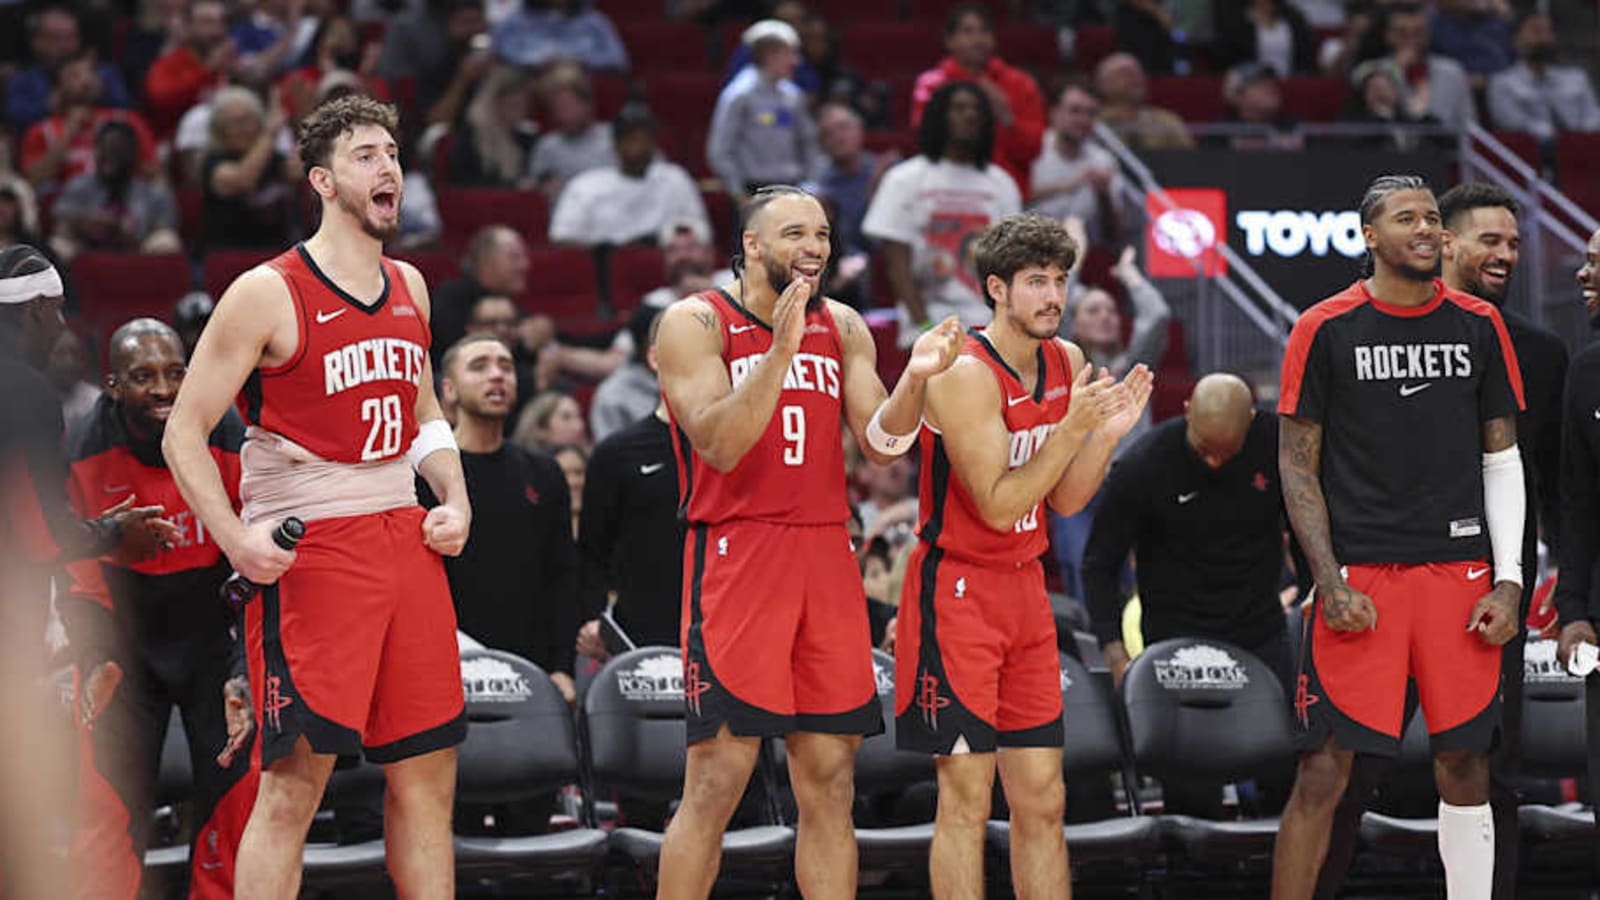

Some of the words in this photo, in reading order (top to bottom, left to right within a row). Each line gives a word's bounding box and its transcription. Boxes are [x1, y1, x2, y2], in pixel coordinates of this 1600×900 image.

[1236, 210, 1367, 258] TOYO
[323, 337, 424, 396] ROCKETS
[1355, 343, 1471, 380] ROCKETS
[361, 394, 402, 461] 28
[782, 405, 806, 465] 9
